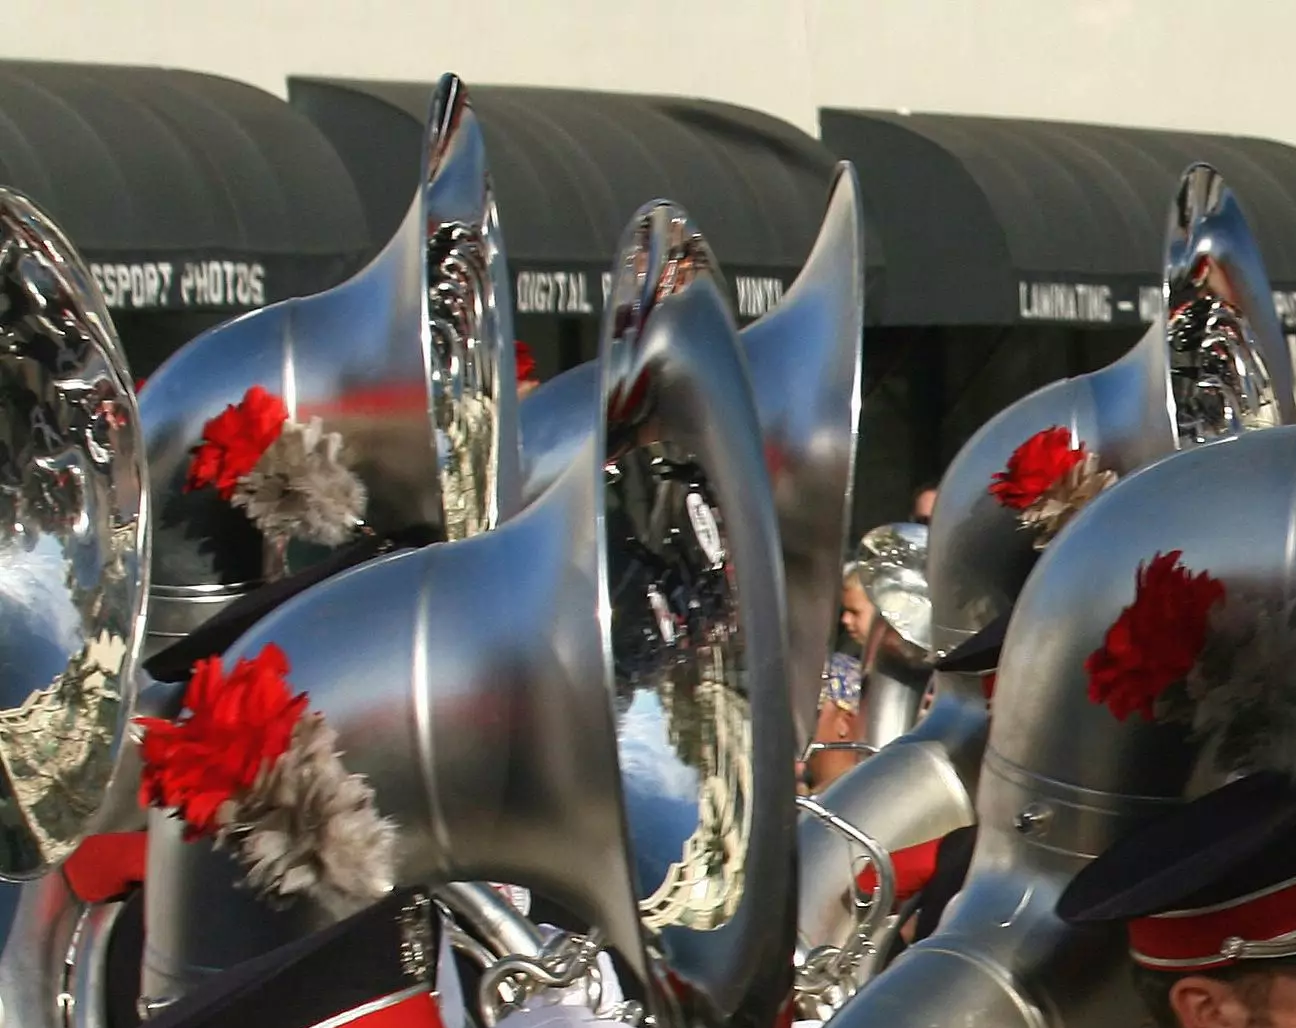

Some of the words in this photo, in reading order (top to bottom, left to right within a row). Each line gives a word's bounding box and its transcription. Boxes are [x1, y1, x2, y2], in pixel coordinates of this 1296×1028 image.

[180, 260, 266, 306] PHOTOS
[516, 270, 594, 314] DIGITAL
[1018, 281, 1112, 322] LAMINATING
